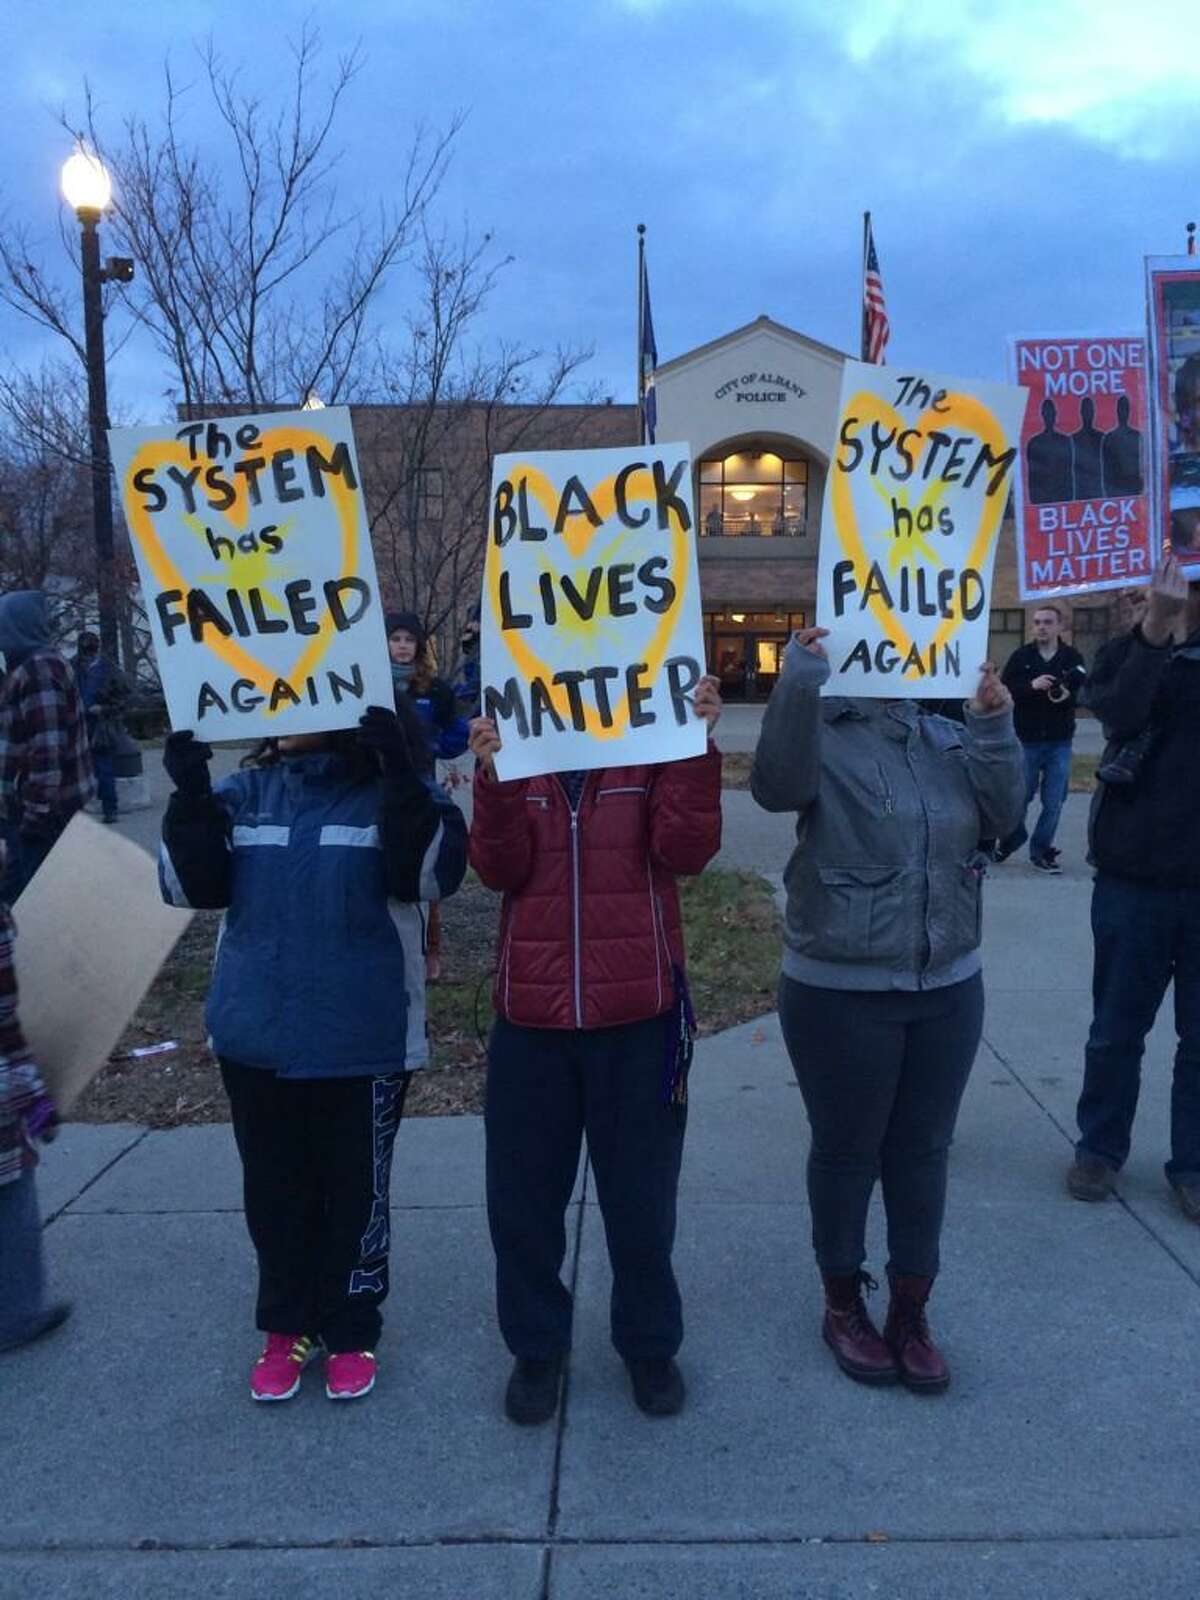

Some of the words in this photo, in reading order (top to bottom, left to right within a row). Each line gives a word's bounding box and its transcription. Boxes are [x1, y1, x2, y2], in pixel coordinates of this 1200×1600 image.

[1019, 344, 1079, 371] NOT
[1086, 343, 1144, 369] ONE
[715, 378, 739, 399] CITY
[741, 373, 757, 384] OF
[736, 392, 786, 402] POLICE
[893, 376, 951, 412] The
[1044, 370, 1126, 398] MORE
[175, 423, 263, 460] The
[837, 417, 1018, 497] SYSTEM
[133, 442, 359, 514] SYSTEM
[492, 459, 692, 549] BLACK
[891, 497, 955, 538] has
[1038, 499, 1137, 532] BLACK
[206, 524, 284, 561] has
[1048, 525, 1130, 558] LIVES
[1031, 549, 1146, 585] MATTER
[499, 556, 677, 631] LIVES
[832, 559, 985, 622] FAILED
[154, 576, 372, 647] FAILED
[839, 639, 961, 678] AGAIN
[197, 663, 364, 721] AGAIN
[483, 655, 701, 740] MATTER
